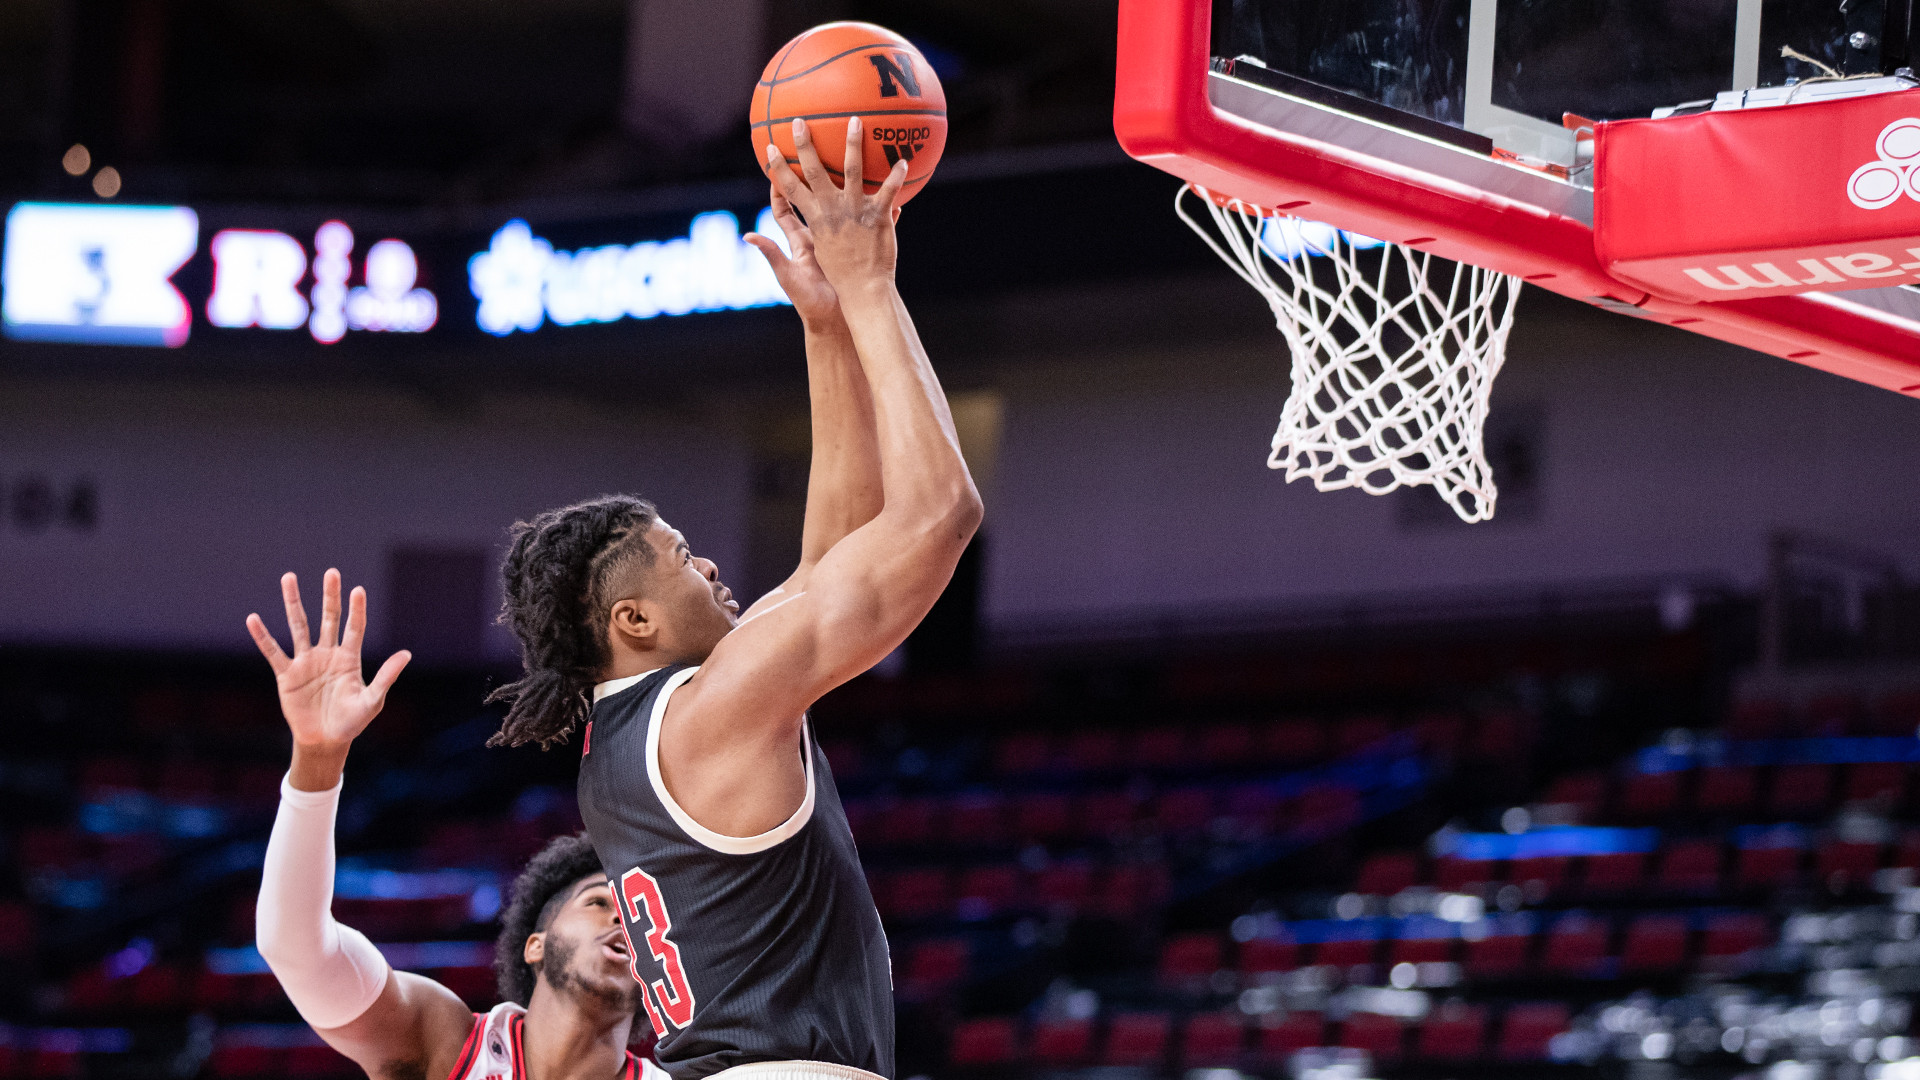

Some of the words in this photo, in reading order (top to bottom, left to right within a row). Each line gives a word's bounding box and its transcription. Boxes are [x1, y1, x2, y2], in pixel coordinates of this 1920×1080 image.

[869, 53, 921, 97] N
[873, 127, 930, 145] adidas
[608, 866, 695, 1040] 3
